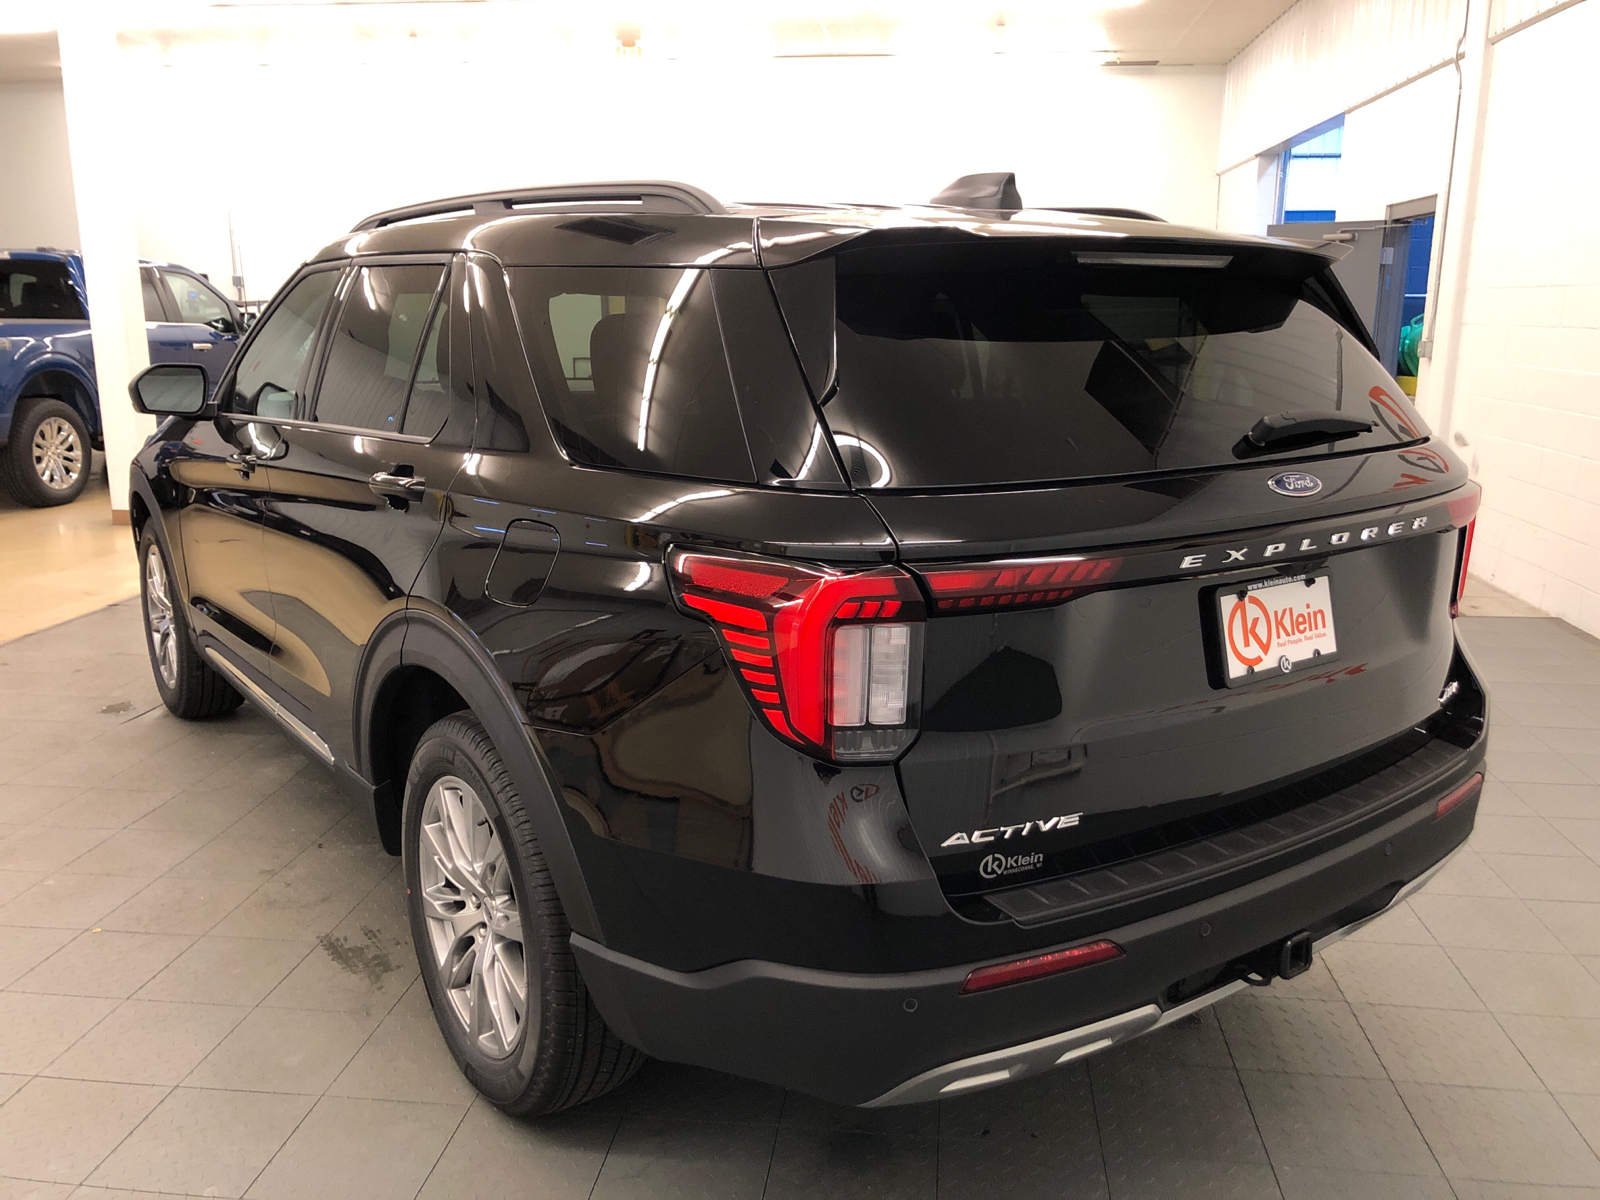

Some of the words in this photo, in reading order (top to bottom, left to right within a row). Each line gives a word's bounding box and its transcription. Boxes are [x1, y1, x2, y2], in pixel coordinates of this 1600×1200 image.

[1282, 474, 1314, 490] Ford
[1179, 516, 1428, 569] EXPLORER
[1247, 574, 1306, 591] www.kleinauto.com
[1273, 603, 1327, 639] Klein
[1276, 640, 1287, 648] Real
[1287, 637, 1303, 646] People.
[940, 812, 1084, 847] ACTIVE
[1006, 852, 1044, 869] Klein
